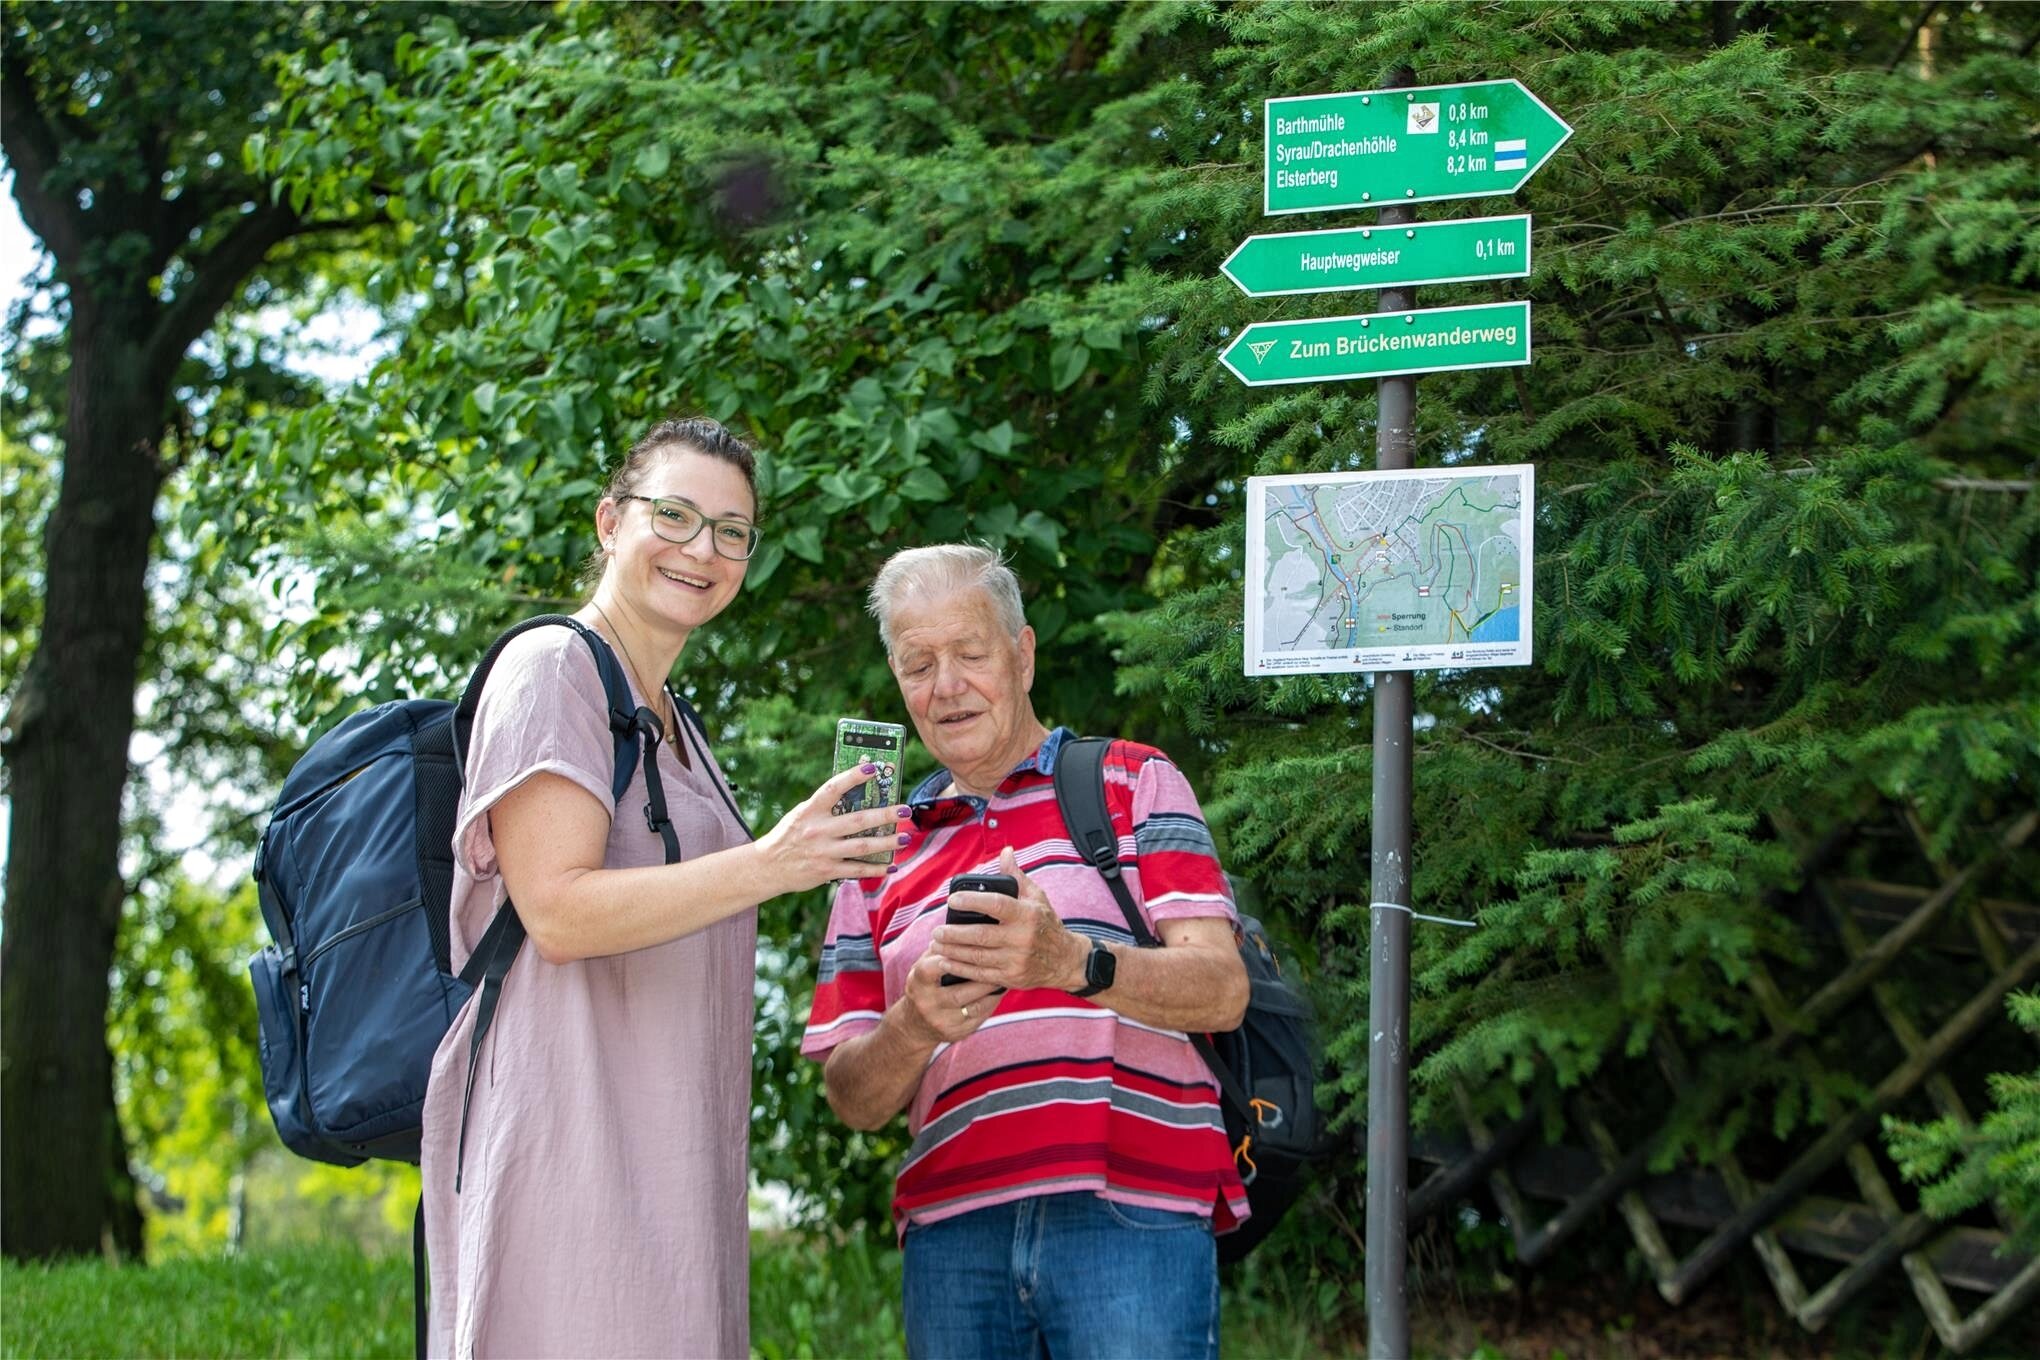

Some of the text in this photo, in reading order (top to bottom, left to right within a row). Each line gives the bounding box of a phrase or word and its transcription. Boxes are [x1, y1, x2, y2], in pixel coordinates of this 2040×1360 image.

[1449, 102, 1488, 121] 0,8 km
[1276, 114, 1345, 136] Barthmühle
[1449, 129, 1488, 148] 8,4 km
[1276, 136, 1397, 164] Syrau/Drachenhöhle
[1447, 155, 1487, 174] 8,2 km
[1276, 169, 1338, 189] Elsterberg
[1476, 239, 1515, 259] 0,1 km
[1301, 248, 1400, 273] Hauptwegweiser
[1290, 325, 1517, 359] Zum Brückenwanderweg
[1391, 613, 1426, 621] Sperrung
